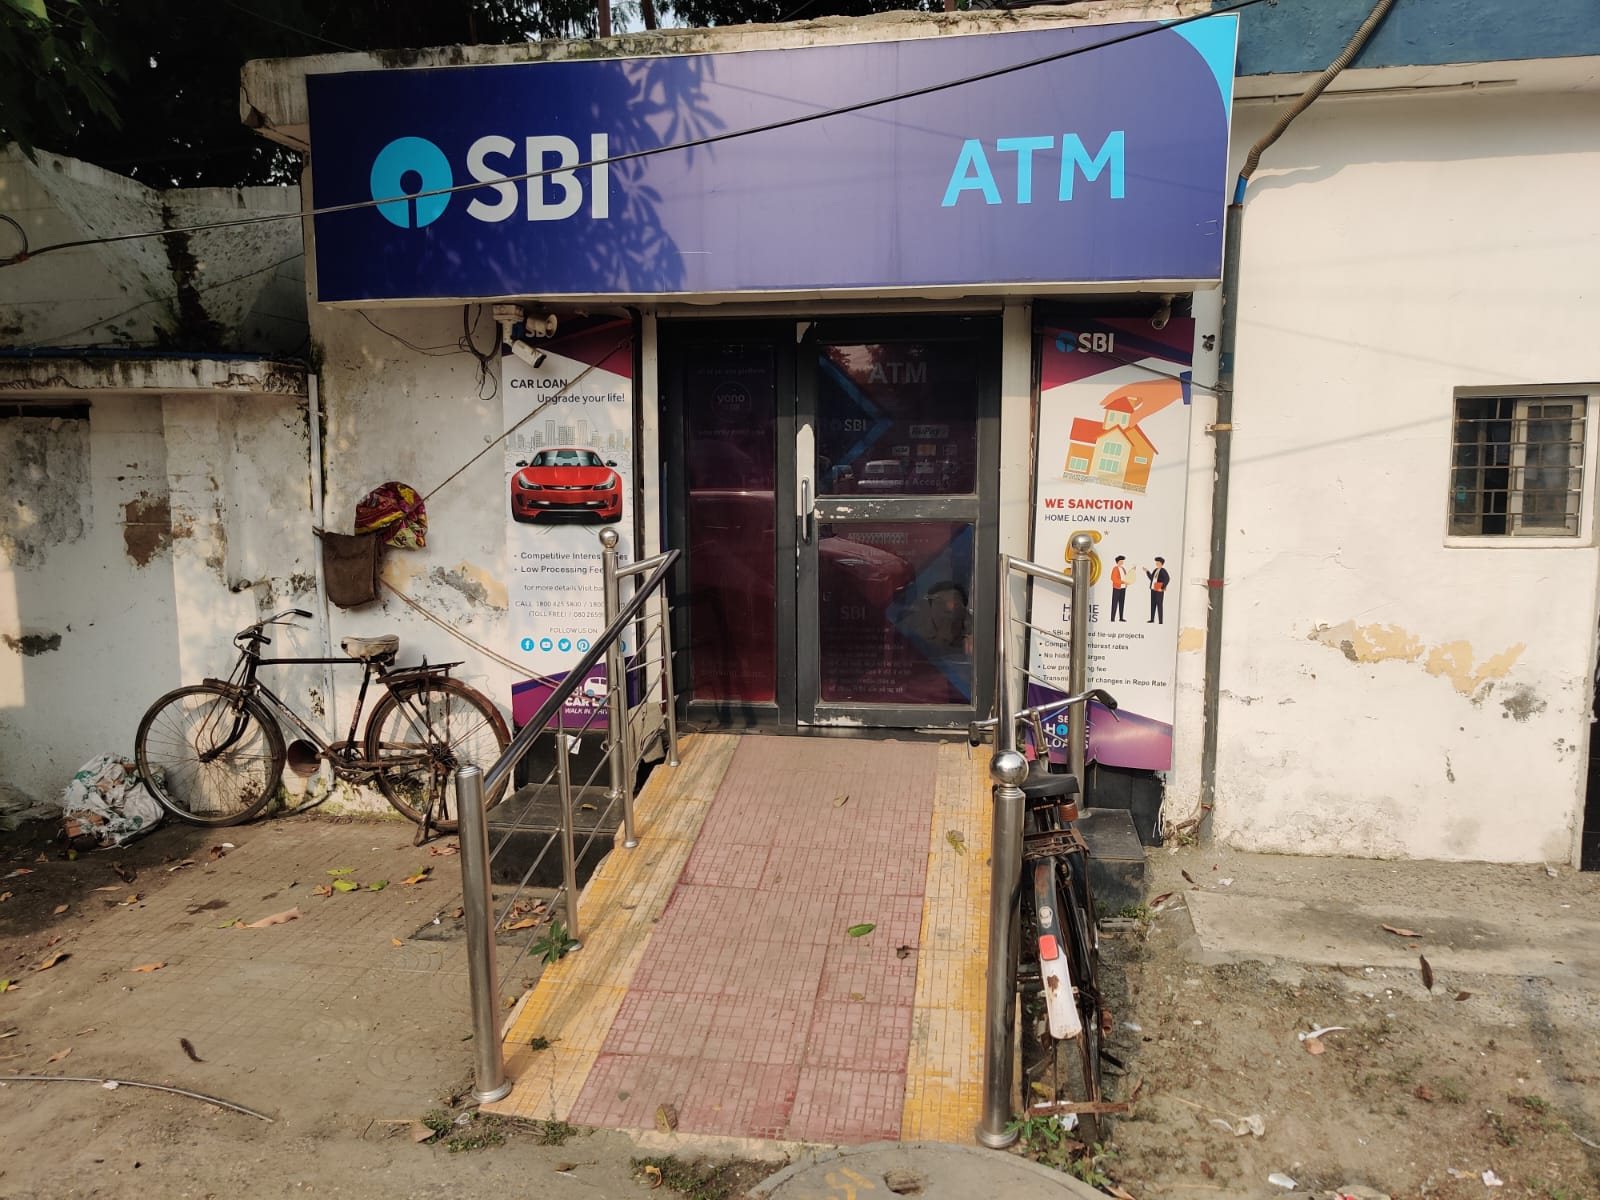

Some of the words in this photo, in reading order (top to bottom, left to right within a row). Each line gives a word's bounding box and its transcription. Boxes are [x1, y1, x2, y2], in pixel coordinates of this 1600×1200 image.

[941, 131, 1125, 207] ATM
[466, 133, 608, 222] SBI
[1078, 332, 1114, 353] SBI
[867, 361, 928, 385] ATM
[510, 379, 534, 389] CAR
[536, 379, 568, 389] LOAN
[537, 393, 580, 405] Upgrade
[582, 395, 606, 405] your
[607, 393, 625, 403] life!
[844, 418, 866, 432] SBI
[1045, 498, 1065, 509] WE
[1067, 498, 1133, 511] SANCTION
[1044, 514, 1070, 522] HOME
[1072, 514, 1096, 523] LOAN
[520, 551, 571, 561] Competitive
[572, 552, 601, 560] Interes
[520, 565, 539, 573] Low
[540, 565, 588, 576] Processing
[1117, 632, 1145, 640] projects
